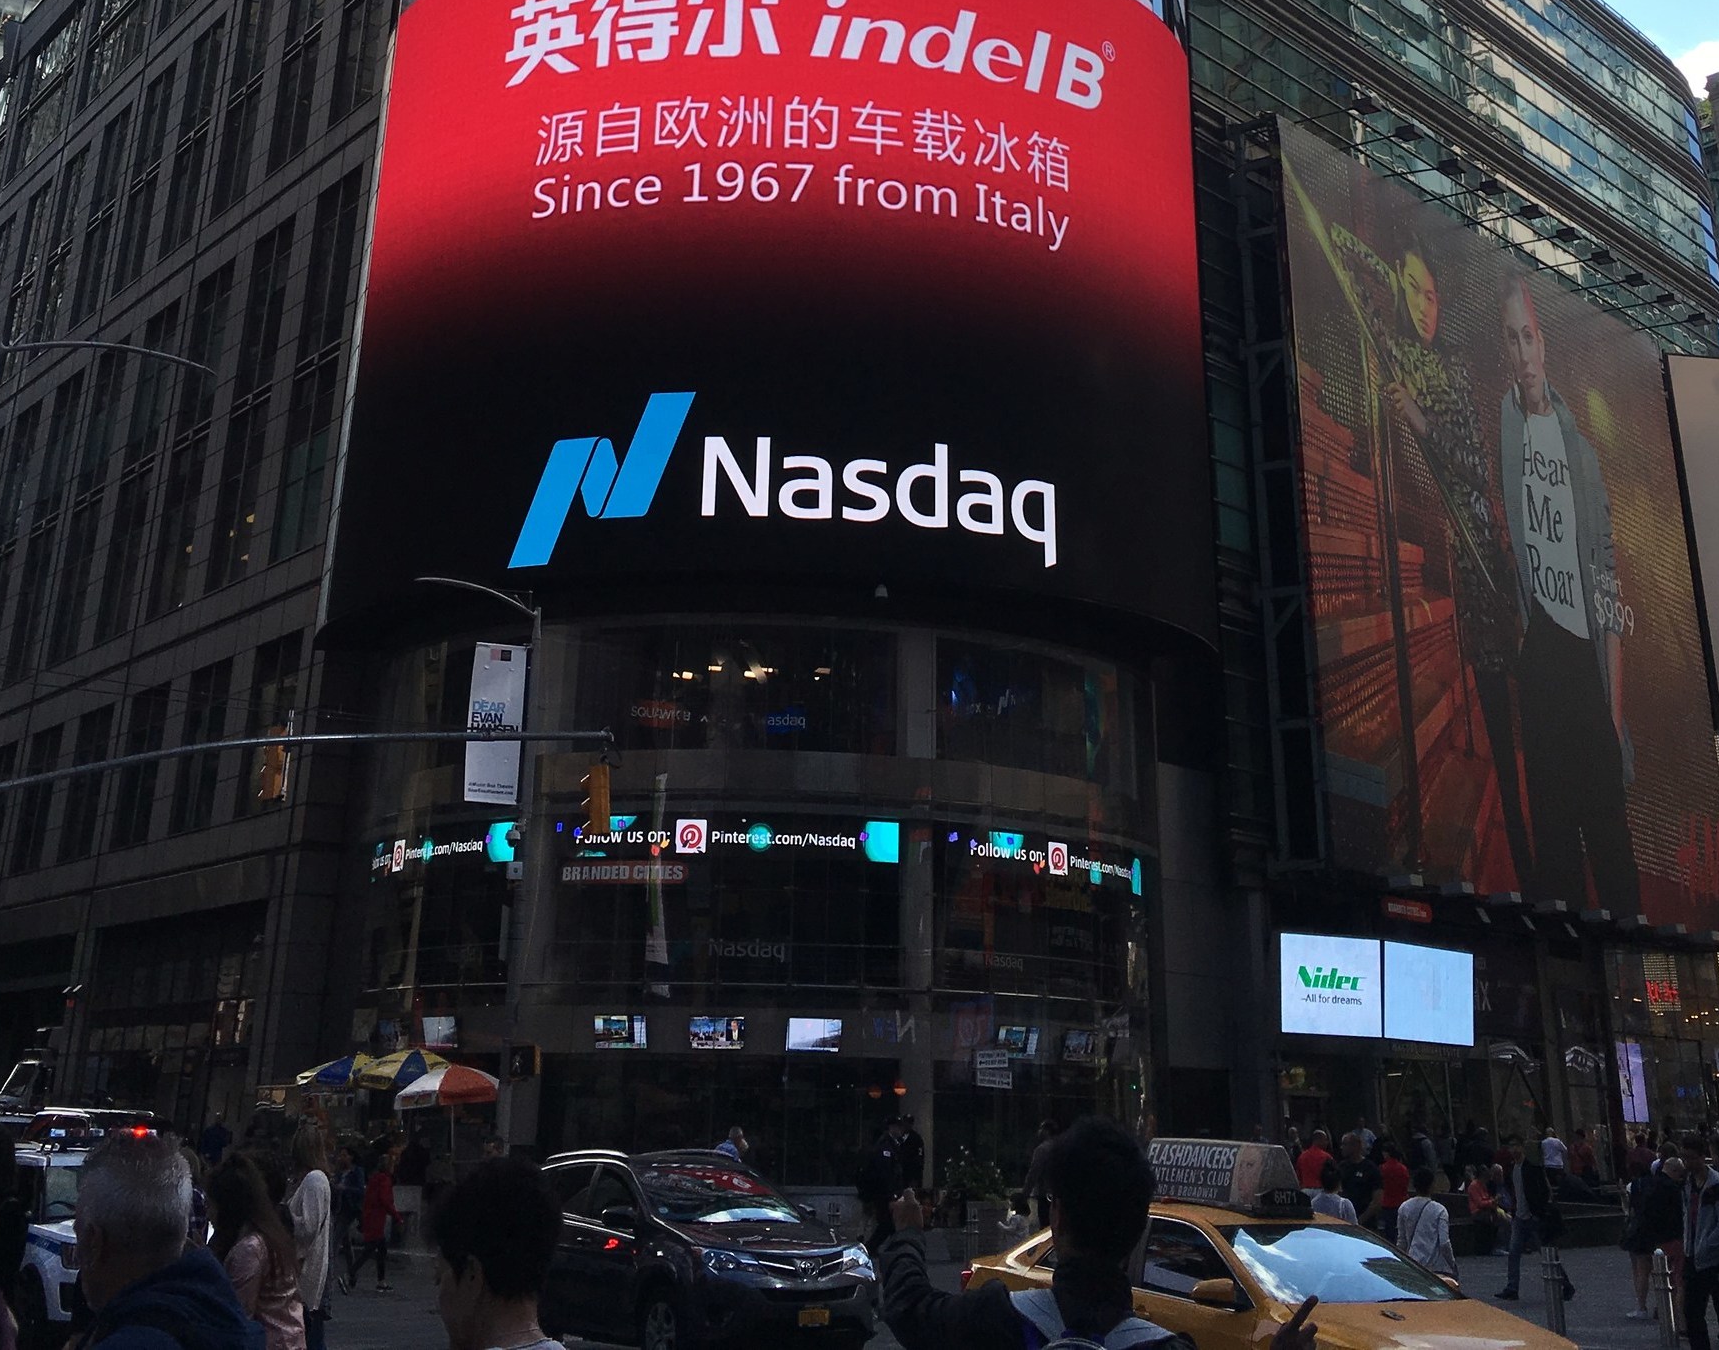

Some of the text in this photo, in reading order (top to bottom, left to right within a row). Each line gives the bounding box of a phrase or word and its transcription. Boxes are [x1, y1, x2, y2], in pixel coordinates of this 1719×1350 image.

[534, 95, 1070, 192] 源自欧洲的车载冰箱
[532, 163, 1070, 251] Since 1967 from Italy
[1522, 443, 1568, 487] Hear
[701, 436, 1057, 568] Nasdaq
[1525, 484, 1564, 543] Me
[1525, 544, 1575, 609] Roar
[1589, 564, 1623, 597] T-shirt
[1594, 589, 1635, 636] $9.99
[471, 712, 503, 723] EVAN
[472, 700, 506, 713] DEAR
[562, 865, 630, 881] BRANDED
[1319, 994, 1330, 1003] for
[1332, 995, 1362, 1005] dreams
[1148, 1143, 1237, 1169] FLASHDANCERS
[1150, 1166, 1231, 1186] NTLEMEN'S CLUB
